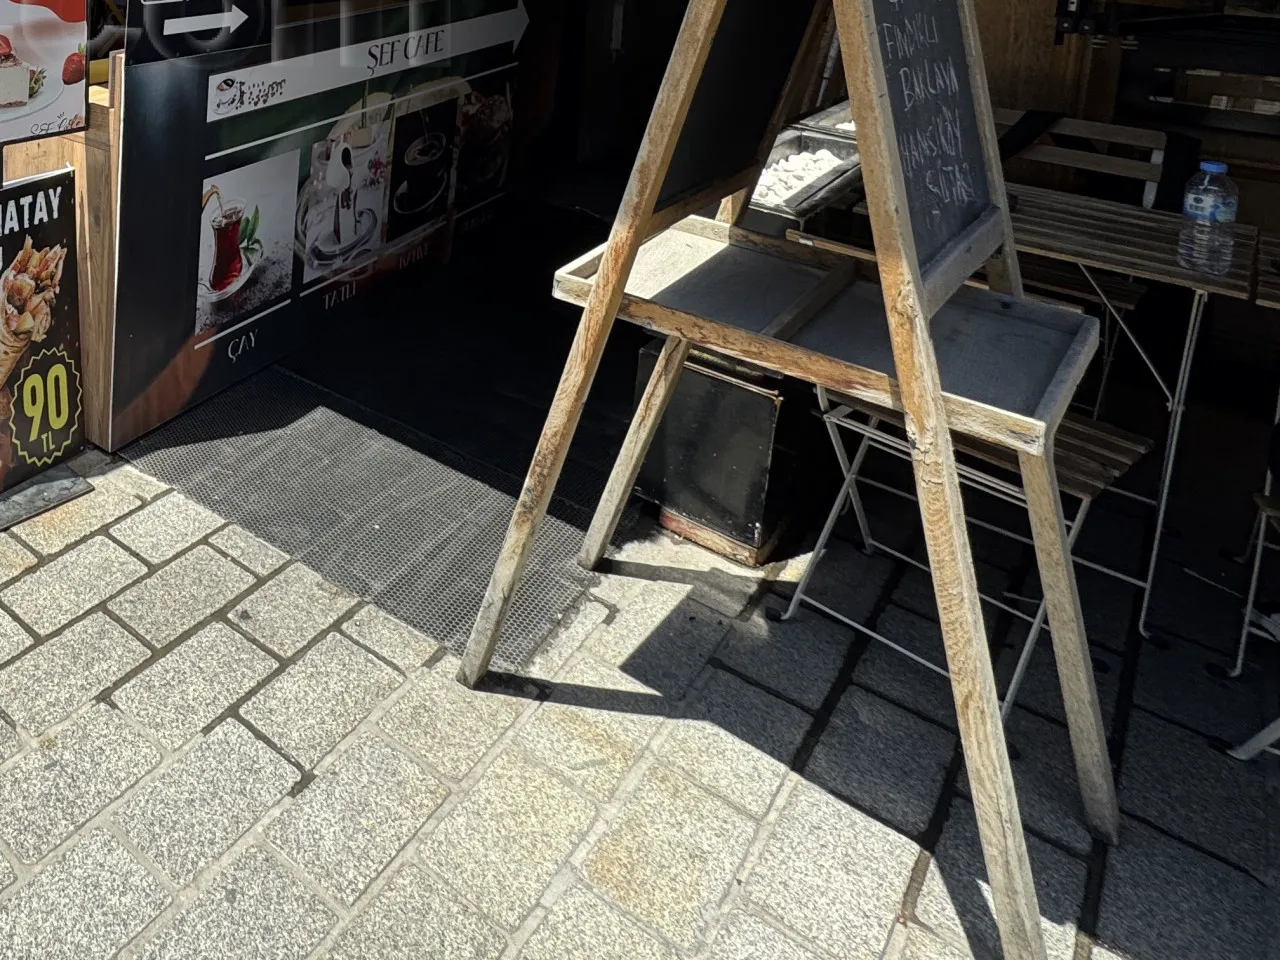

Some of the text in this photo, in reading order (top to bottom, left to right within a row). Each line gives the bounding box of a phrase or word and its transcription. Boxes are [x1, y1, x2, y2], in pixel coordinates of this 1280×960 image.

[367, 29, 445, 77] ŞEF CAFE
[226, 327, 260, 363] ÇAY
[23, 363, 69, 443] 90
[40, 431, 56, 453] TL
